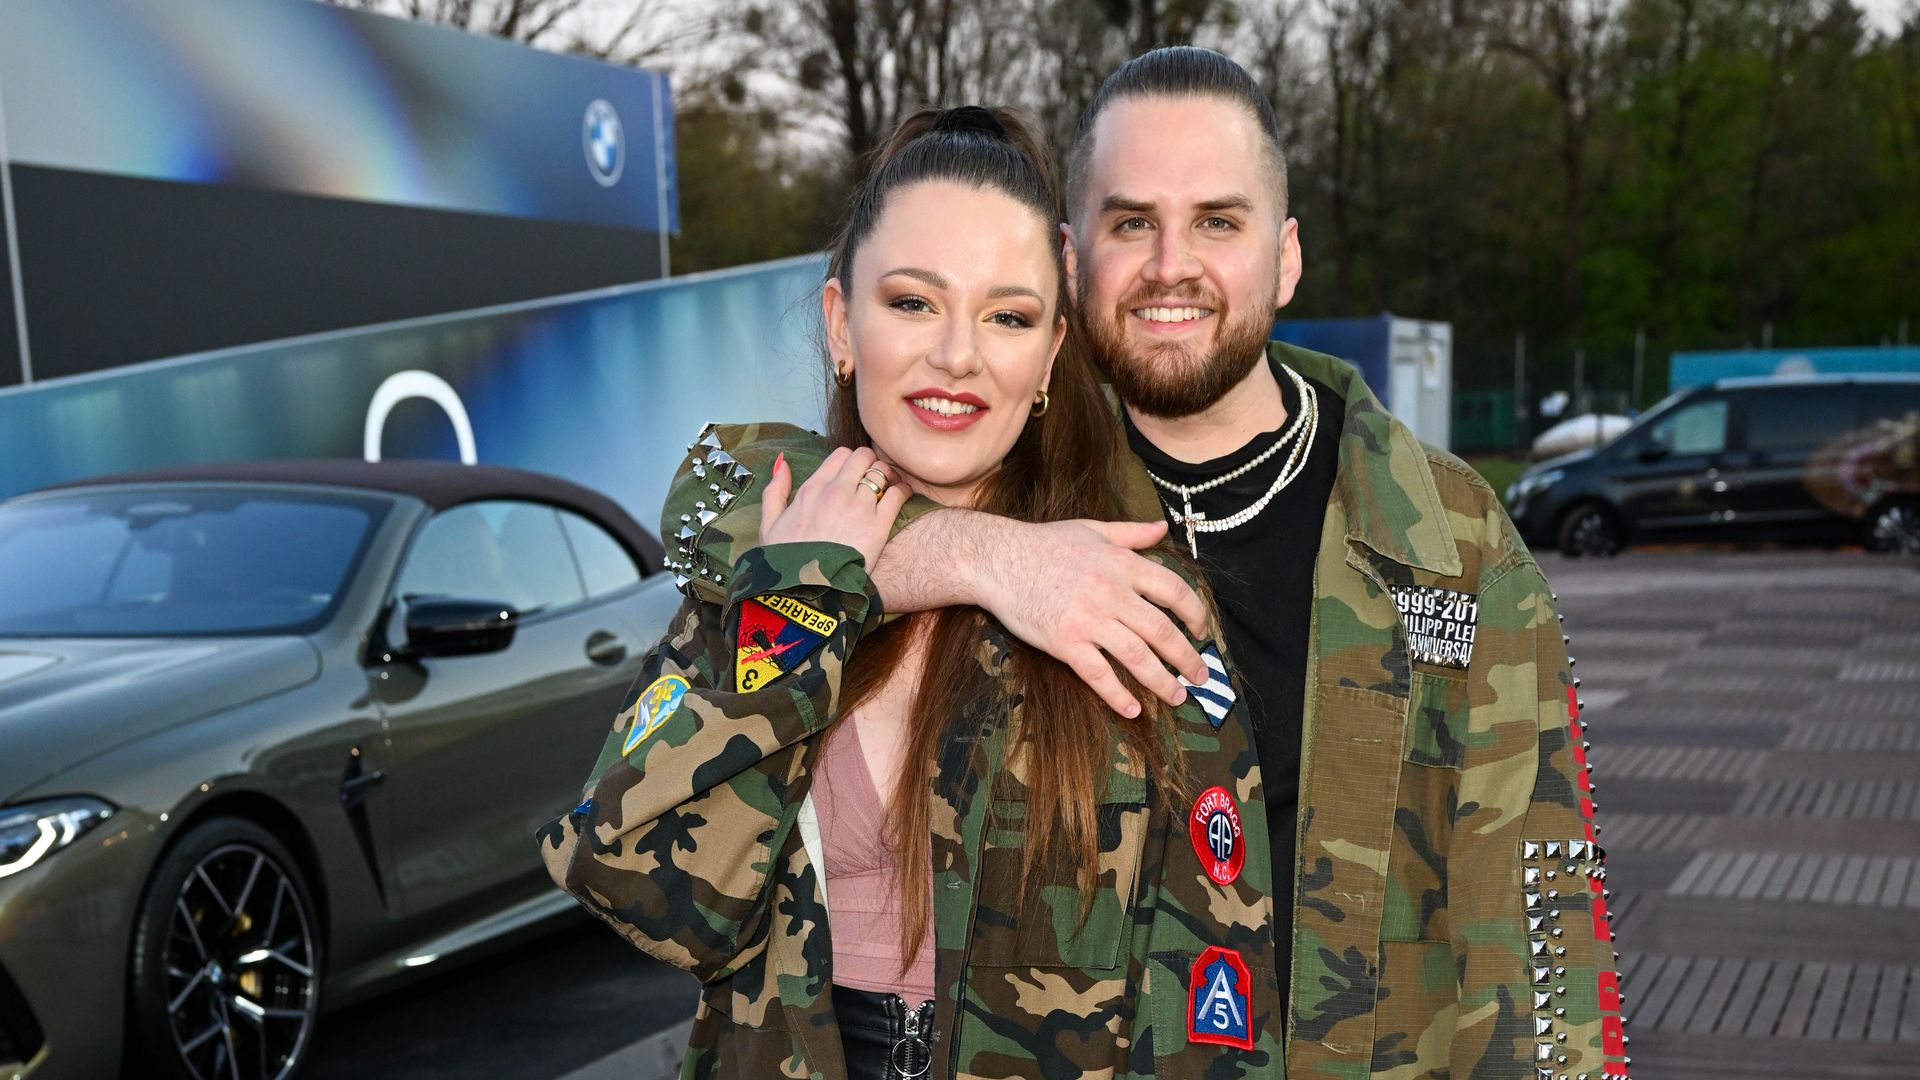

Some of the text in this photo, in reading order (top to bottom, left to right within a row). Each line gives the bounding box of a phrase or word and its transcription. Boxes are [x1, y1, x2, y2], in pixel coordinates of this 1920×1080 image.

[1391, 592, 1477, 623] 999-201
[742, 669, 758, 690] 3
[1195, 793, 1241, 838] FORT BRAGG
[1197, 966, 1243, 1027] A
[1213, 1003, 1229, 1030] 5
